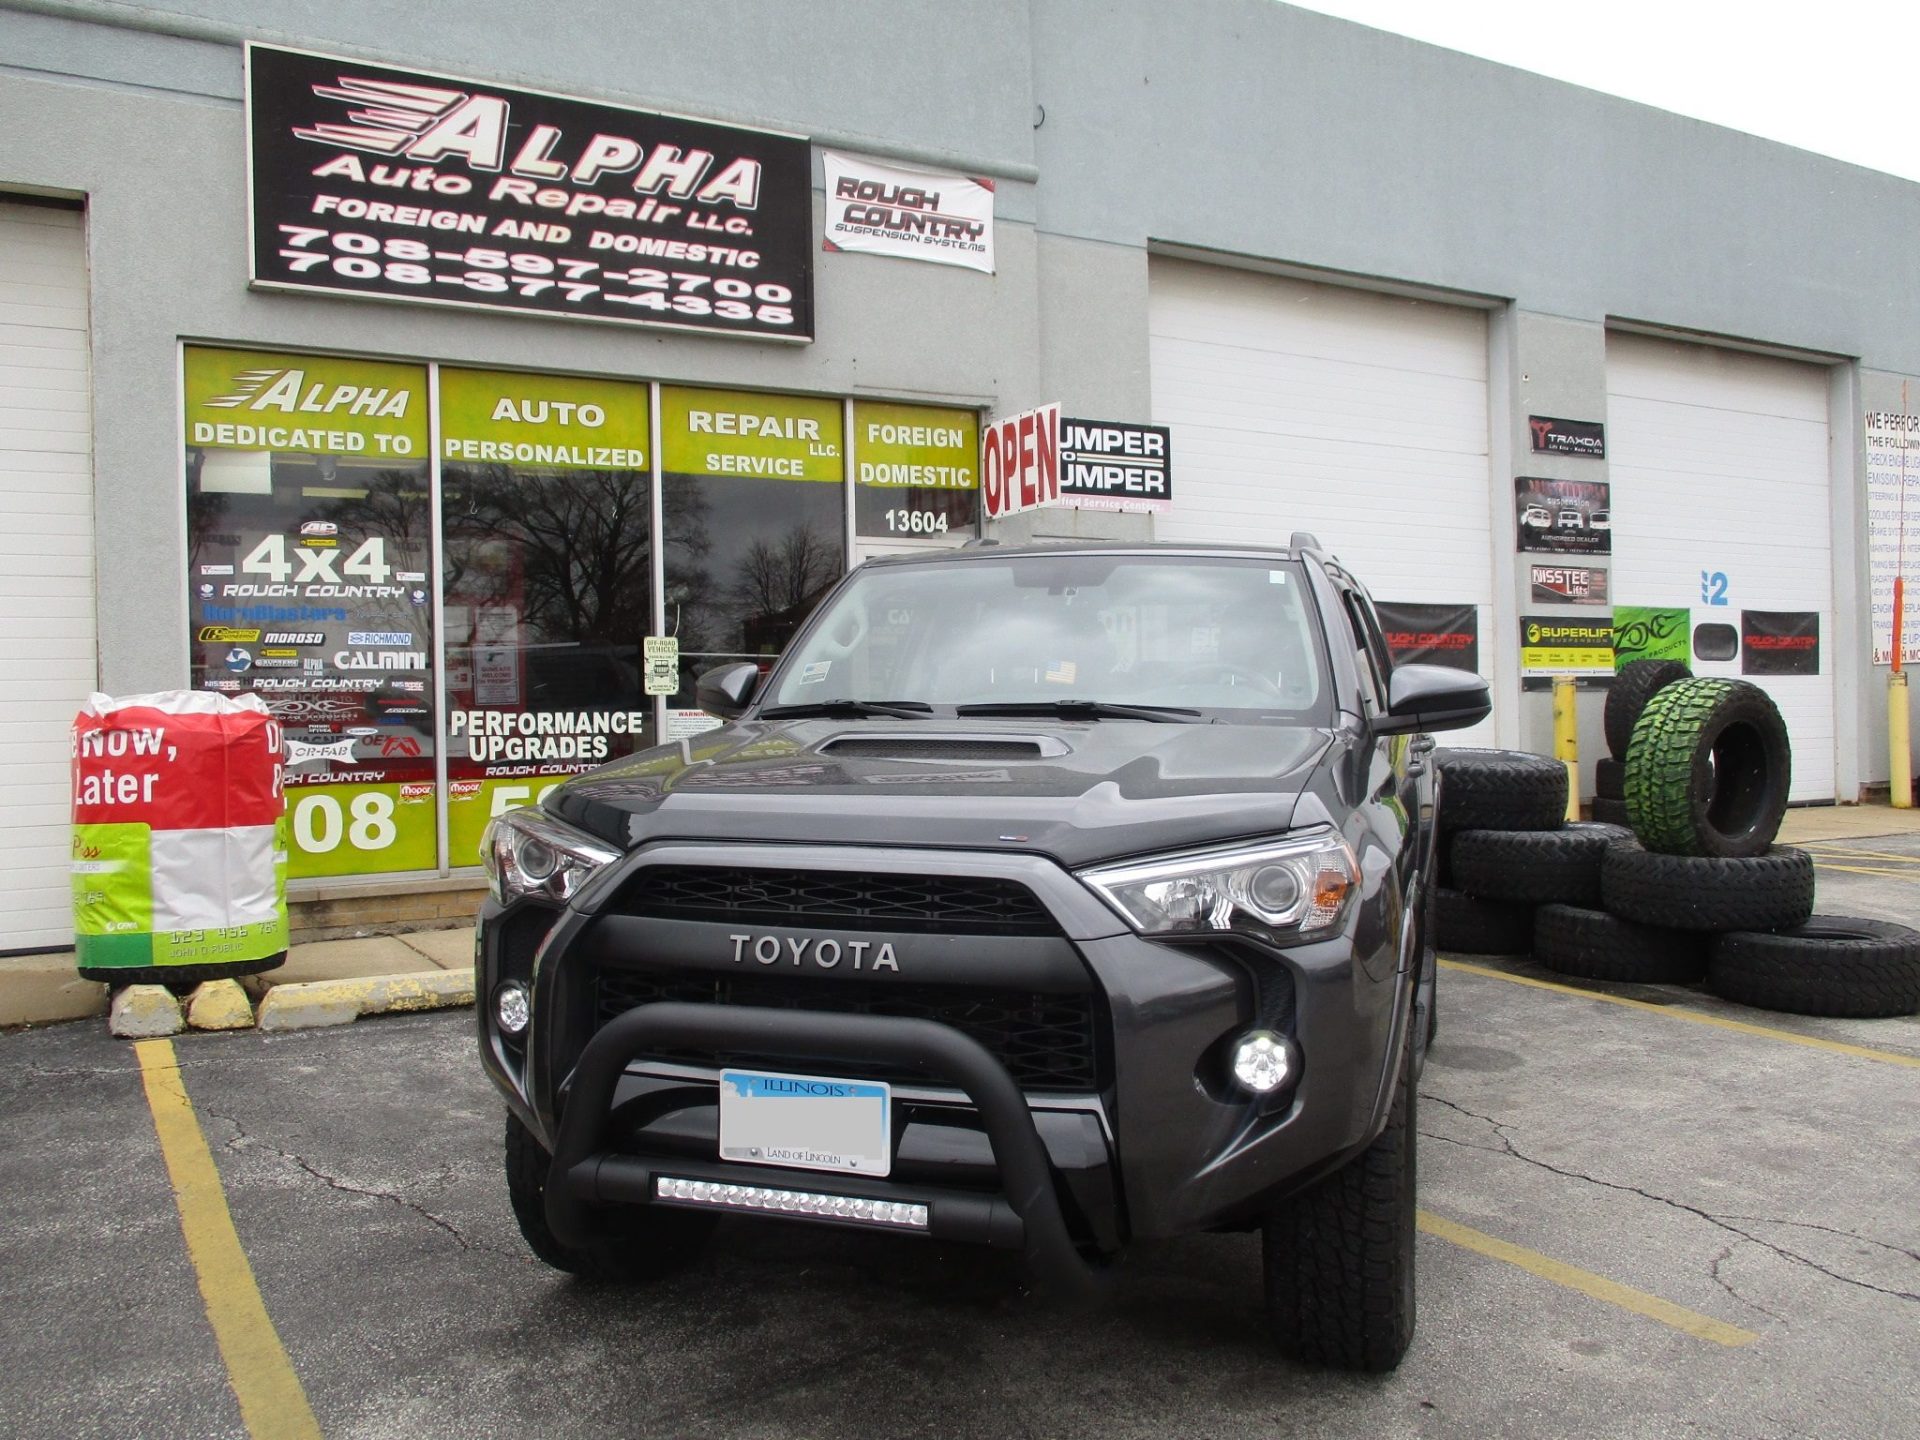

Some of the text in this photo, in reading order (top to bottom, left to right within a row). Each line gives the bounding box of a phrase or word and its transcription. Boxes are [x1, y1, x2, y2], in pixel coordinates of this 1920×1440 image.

[405, 94, 761, 210] ALPHA
[312, 154, 754, 235] Auto Repair LLC.
[835, 176, 941, 211] ROUGH
[312, 194, 761, 268] FOREIGN AND DOMESTIC
[843, 204, 985, 242] COUNTRY
[835, 223, 986, 252] SUSPENSION SYSTEMS
[278, 224, 792, 303] 708-597-2700
[278, 249, 794, 324] 708-377-4335
[250, 369, 410, 418] ALPHA
[491, 397, 605, 427] AUTO
[1866, 411, 1920, 432] WE PERFOR
[194, 422, 412, 454] DEDICATED TO
[689, 410, 840, 457] REPAIR LLC.
[868, 423, 963, 448] FOREIGN
[1060, 425, 1164, 456] UMPER
[1548, 434, 1603, 447] TRAXDA
[1867, 436, 1920, 450] THE FOLLOWIN
[445, 438, 643, 467] PERSONALIZED
[706, 453, 803, 476] SERVICE
[984, 408, 1057, 516] OPEN
[860, 463, 971, 486] DOMESTIC
[1060, 463, 1165, 493] UMPER
[1868, 472, 1901, 486] EMISSION
[1083, 498, 1120, 509] Service
[885, 509, 948, 533] 13604
[242, 534, 391, 584] 4x4
[1533, 568, 1589, 585] NISSTEC
[222, 584, 298, 597] ROUGH
[305, 584, 405, 598] COUNTRY
[264, 633, 323, 644] MOROSO
[364, 633, 411, 645] RICHMOND
[1541, 627, 1614, 638] SUPERLIFT
[334, 651, 425, 670] CALMINI
[1873, 647, 1920, 662] & MUH MO
[253, 678, 307, 688] ROUGH
[312, 678, 384, 688] COUNTRY
[451, 710, 643, 736] PERFORMANCE
[295, 746, 348, 758] OR-FAB
[469, 735, 608, 762] UPGRADES
[308, 771, 385, 784] COUNTRY
[486, 765, 536, 776] ROUGH
[450, 781, 481, 794] Mopar
[293, 791, 397, 853] 08
[170, 928, 205, 944] 123
[730, 934, 899, 972] TOYOTA
[763, 1079, 845, 1097] ILLINOIS
[767, 1147, 791, 1159] LAND
[805, 1151, 841, 1164] LINCOLN
